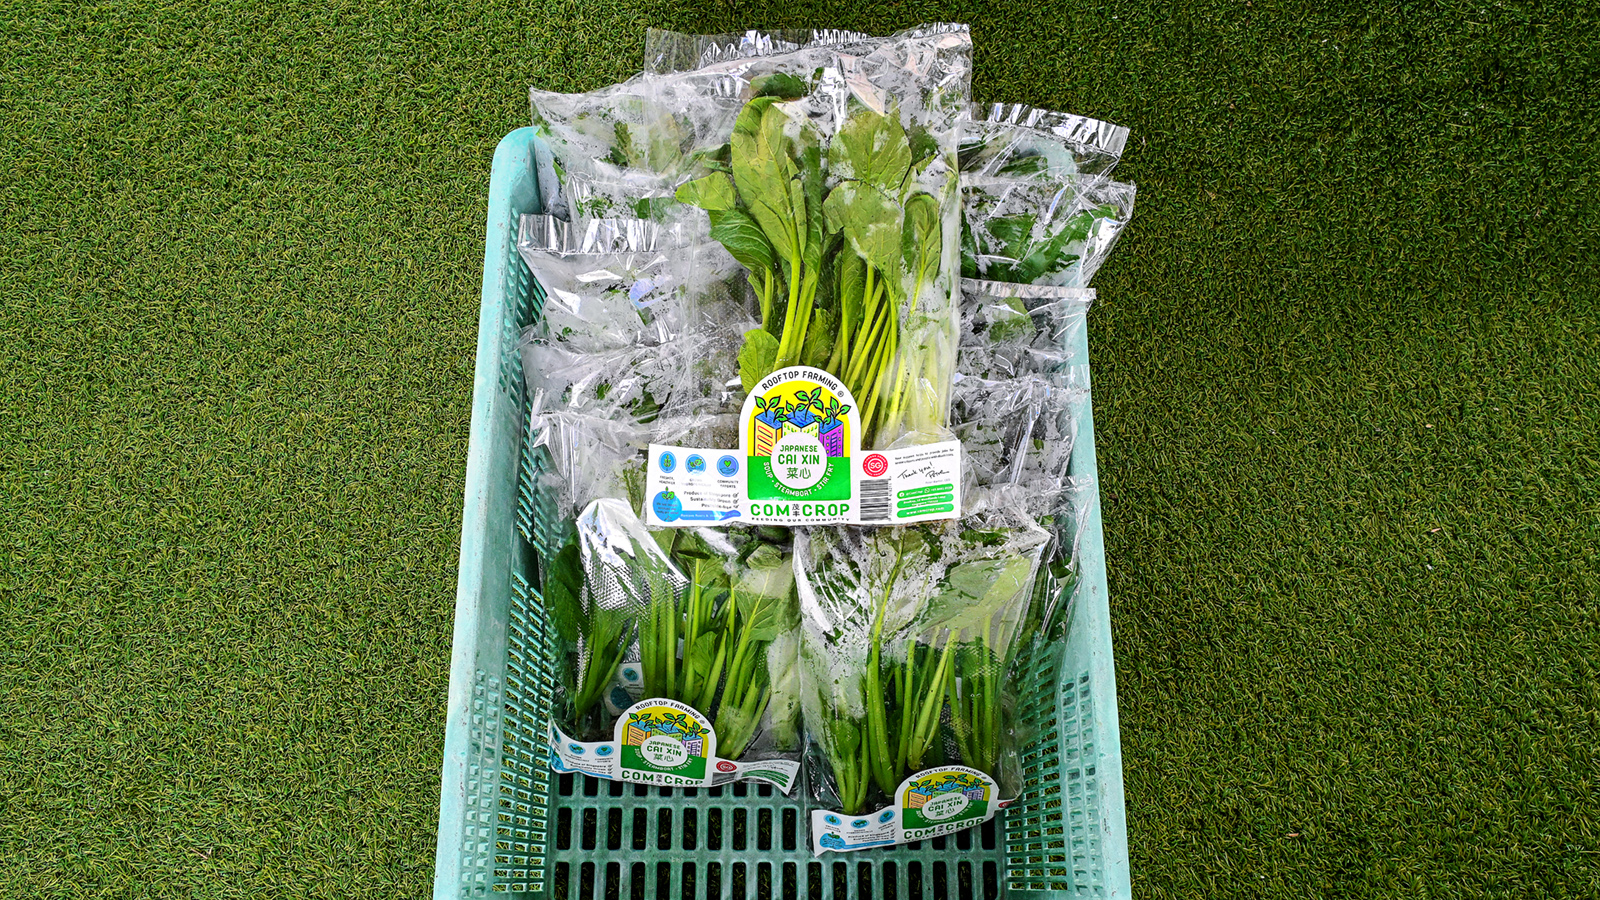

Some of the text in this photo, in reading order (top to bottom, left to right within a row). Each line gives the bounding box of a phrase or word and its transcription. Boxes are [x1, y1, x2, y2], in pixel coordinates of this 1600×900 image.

[761, 370, 838, 391] ROOFTOP FARMING
[779, 444, 818, 453] JAPANESE
[777, 454, 820, 465] CAI XIN
[870, 461, 882, 470] SG
[763, 461, 774, 479] SOUP
[786, 467, 812, 480] 菜心
[816, 462, 834, 490] STIR FRY
[897, 461, 935, 480] Thank you!
[773, 481, 813, 497] STEAMBOAT
[750, 503, 790, 517] COM
[802, 503, 850, 517] CROP
[635, 700, 701, 719] ROOFTOP FARMING
[646, 745, 682, 757] CAI XIN
[648, 740, 681, 749] JAPANESE
[653, 752, 675, 762] 菜心
[621, 770, 655, 782] COM
[664, 775, 704, 786] CROP
[915, 766, 982, 779] ROOFTOP FARMING
[928, 799, 963, 812] CAI XIN
[903, 827, 936, 839] COM
[945, 817, 985, 831] CROP
